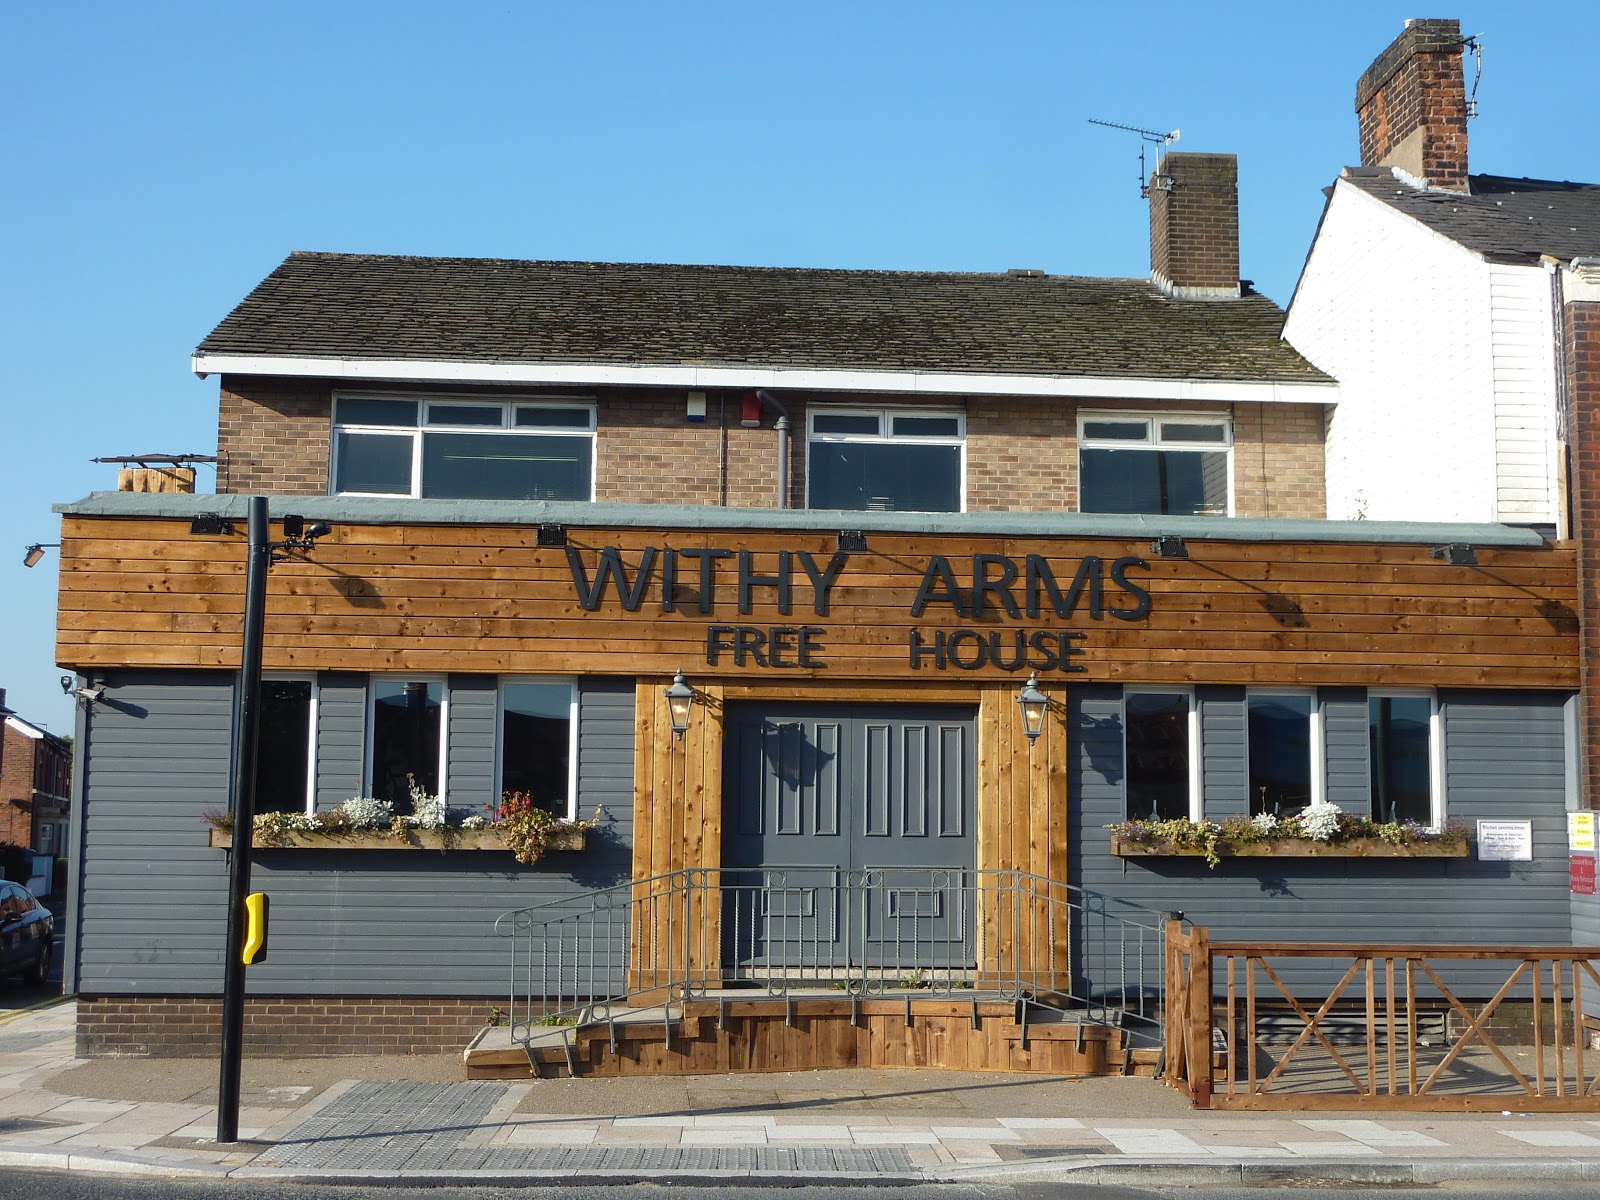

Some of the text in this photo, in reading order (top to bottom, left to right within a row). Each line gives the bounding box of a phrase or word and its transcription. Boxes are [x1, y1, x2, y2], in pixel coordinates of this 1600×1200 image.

[565, 546, 1151, 620] WITHY ARMS
[706, 626, 1087, 671] FREE HOUSE
